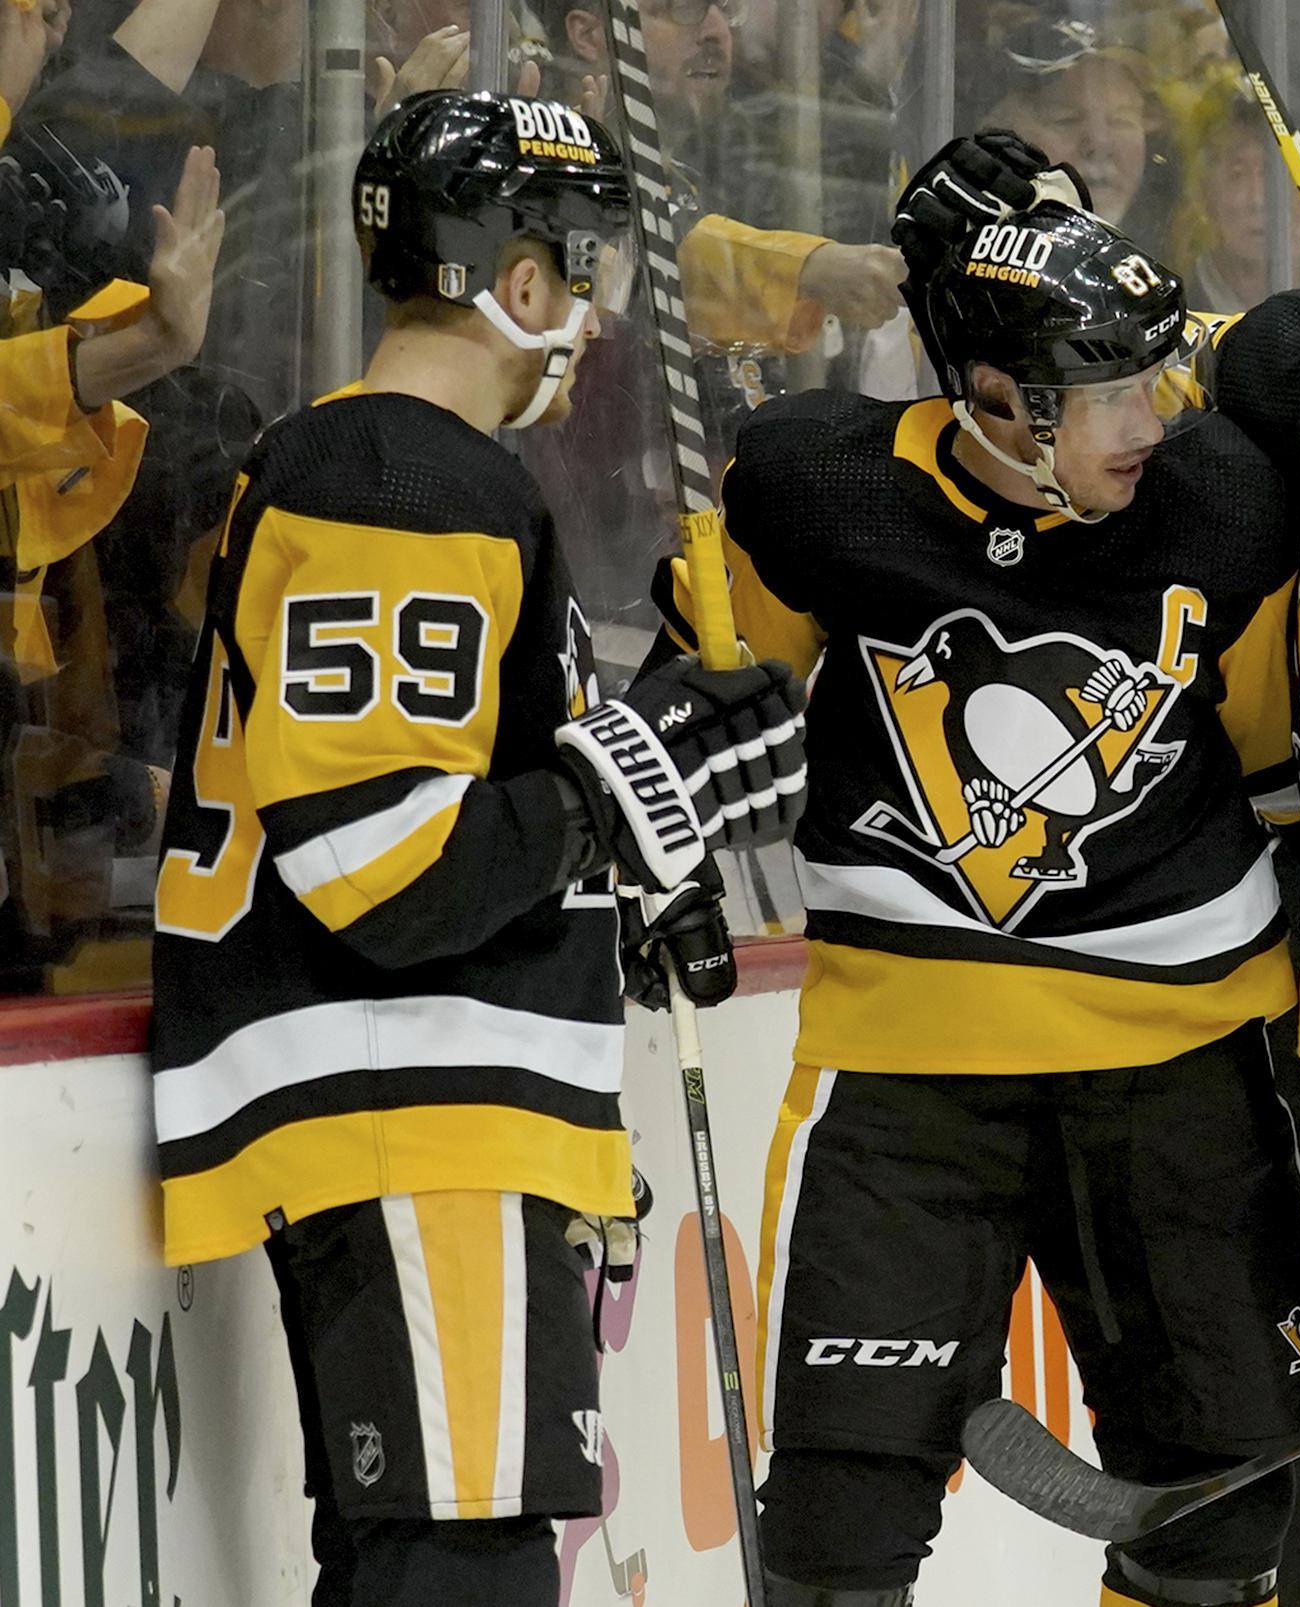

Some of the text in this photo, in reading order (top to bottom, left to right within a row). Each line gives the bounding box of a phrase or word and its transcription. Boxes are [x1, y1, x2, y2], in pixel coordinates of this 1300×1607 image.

[508, 99, 592, 147] BOLD
[1248, 72, 1289, 137] BAUER
[518, 139, 597, 165] PENGUIN
[360, 184, 390, 229] 59
[970, 224, 1053, 271] BOLD
[965, 262, 1042, 289] PENGUIN
[1112, 254, 1162, 297] 87
[1144, 310, 1181, 342] CCM
[279, 590, 489, 728] 59
[1156, 584, 1208, 689] C
[577, 703, 699, 854] WARRI
[694, 1131, 712, 1192] CROSBY
[805, 1338, 960, 1367] CCM
